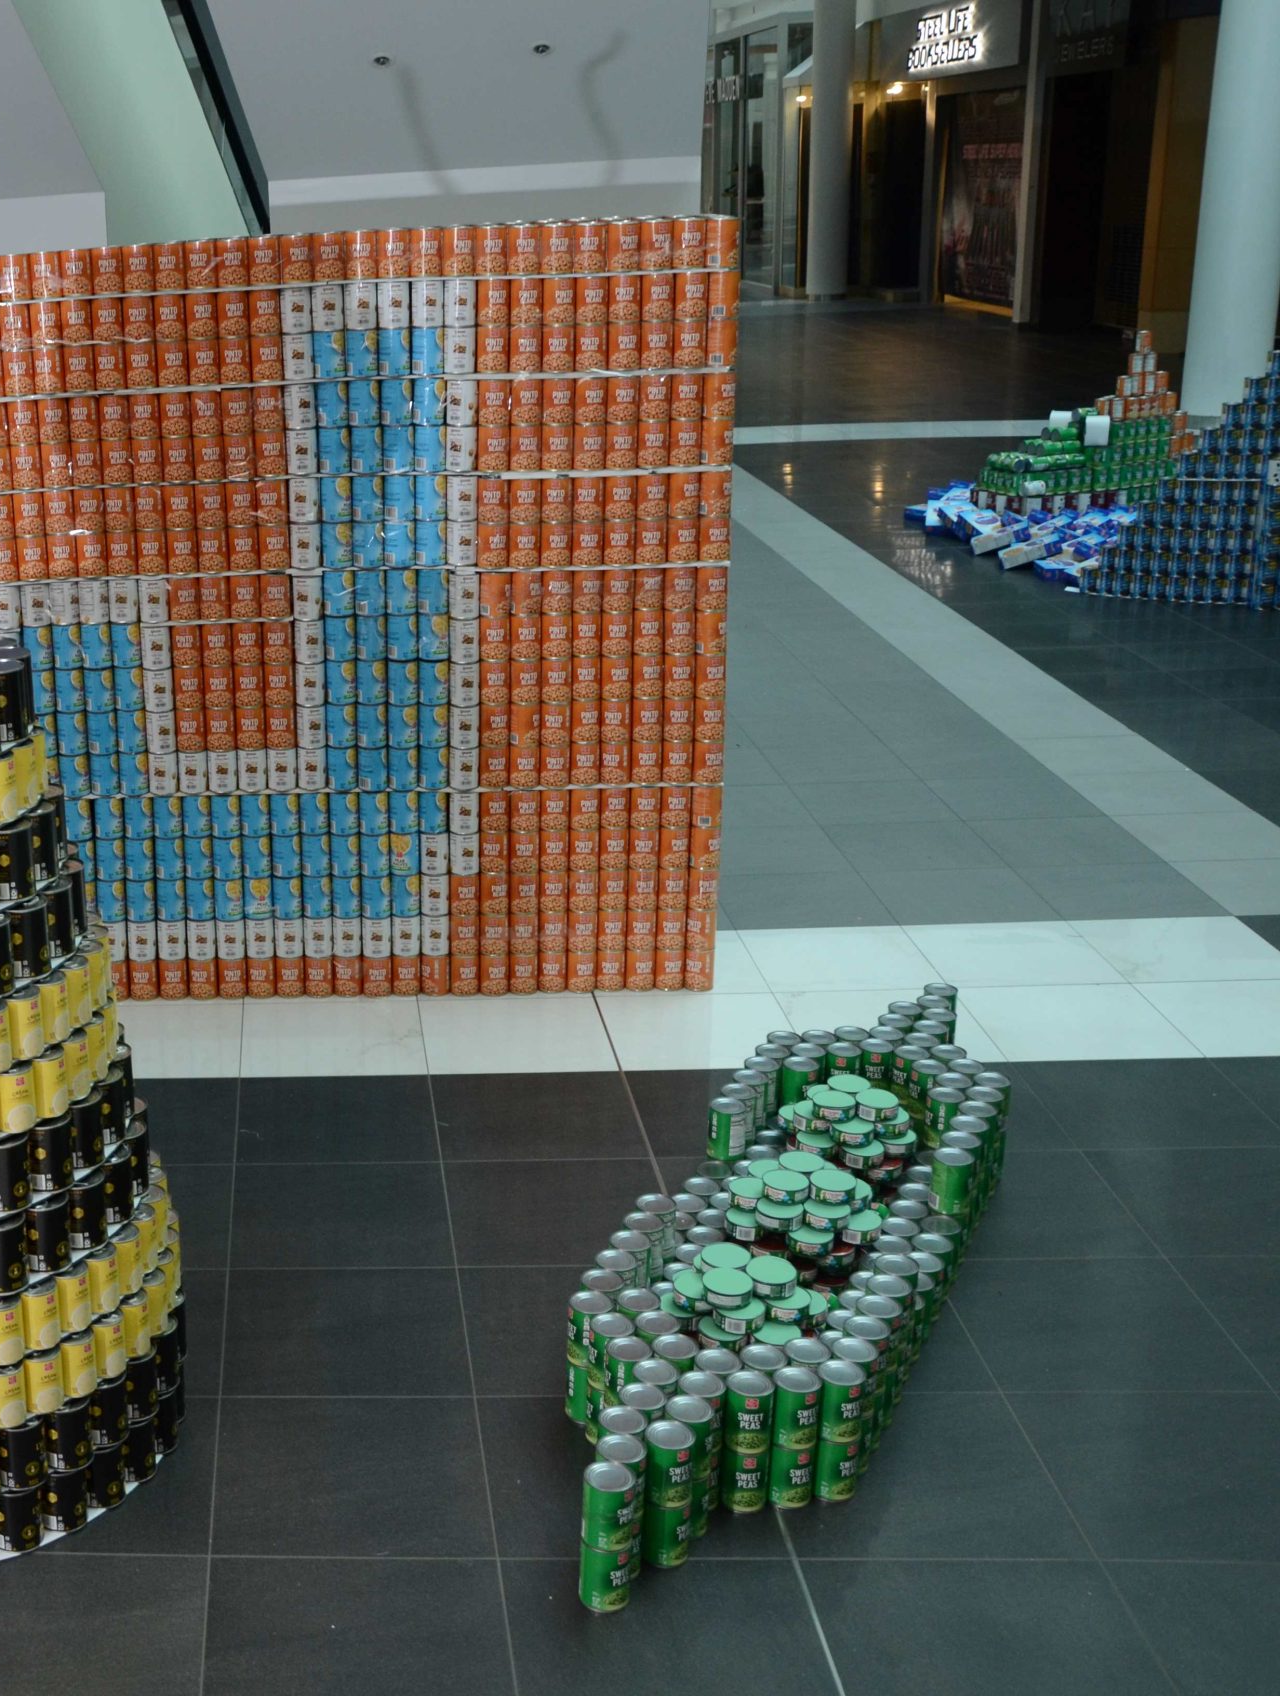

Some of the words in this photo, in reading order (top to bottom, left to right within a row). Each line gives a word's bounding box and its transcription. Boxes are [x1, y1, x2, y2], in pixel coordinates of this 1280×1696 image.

[738, 1412, 764, 1422] SWEET
[740, 1420, 760, 1430] PEAS
[736, 1472, 761, 1481] SWEET
[738, 1480, 758, 1488] PEAS
